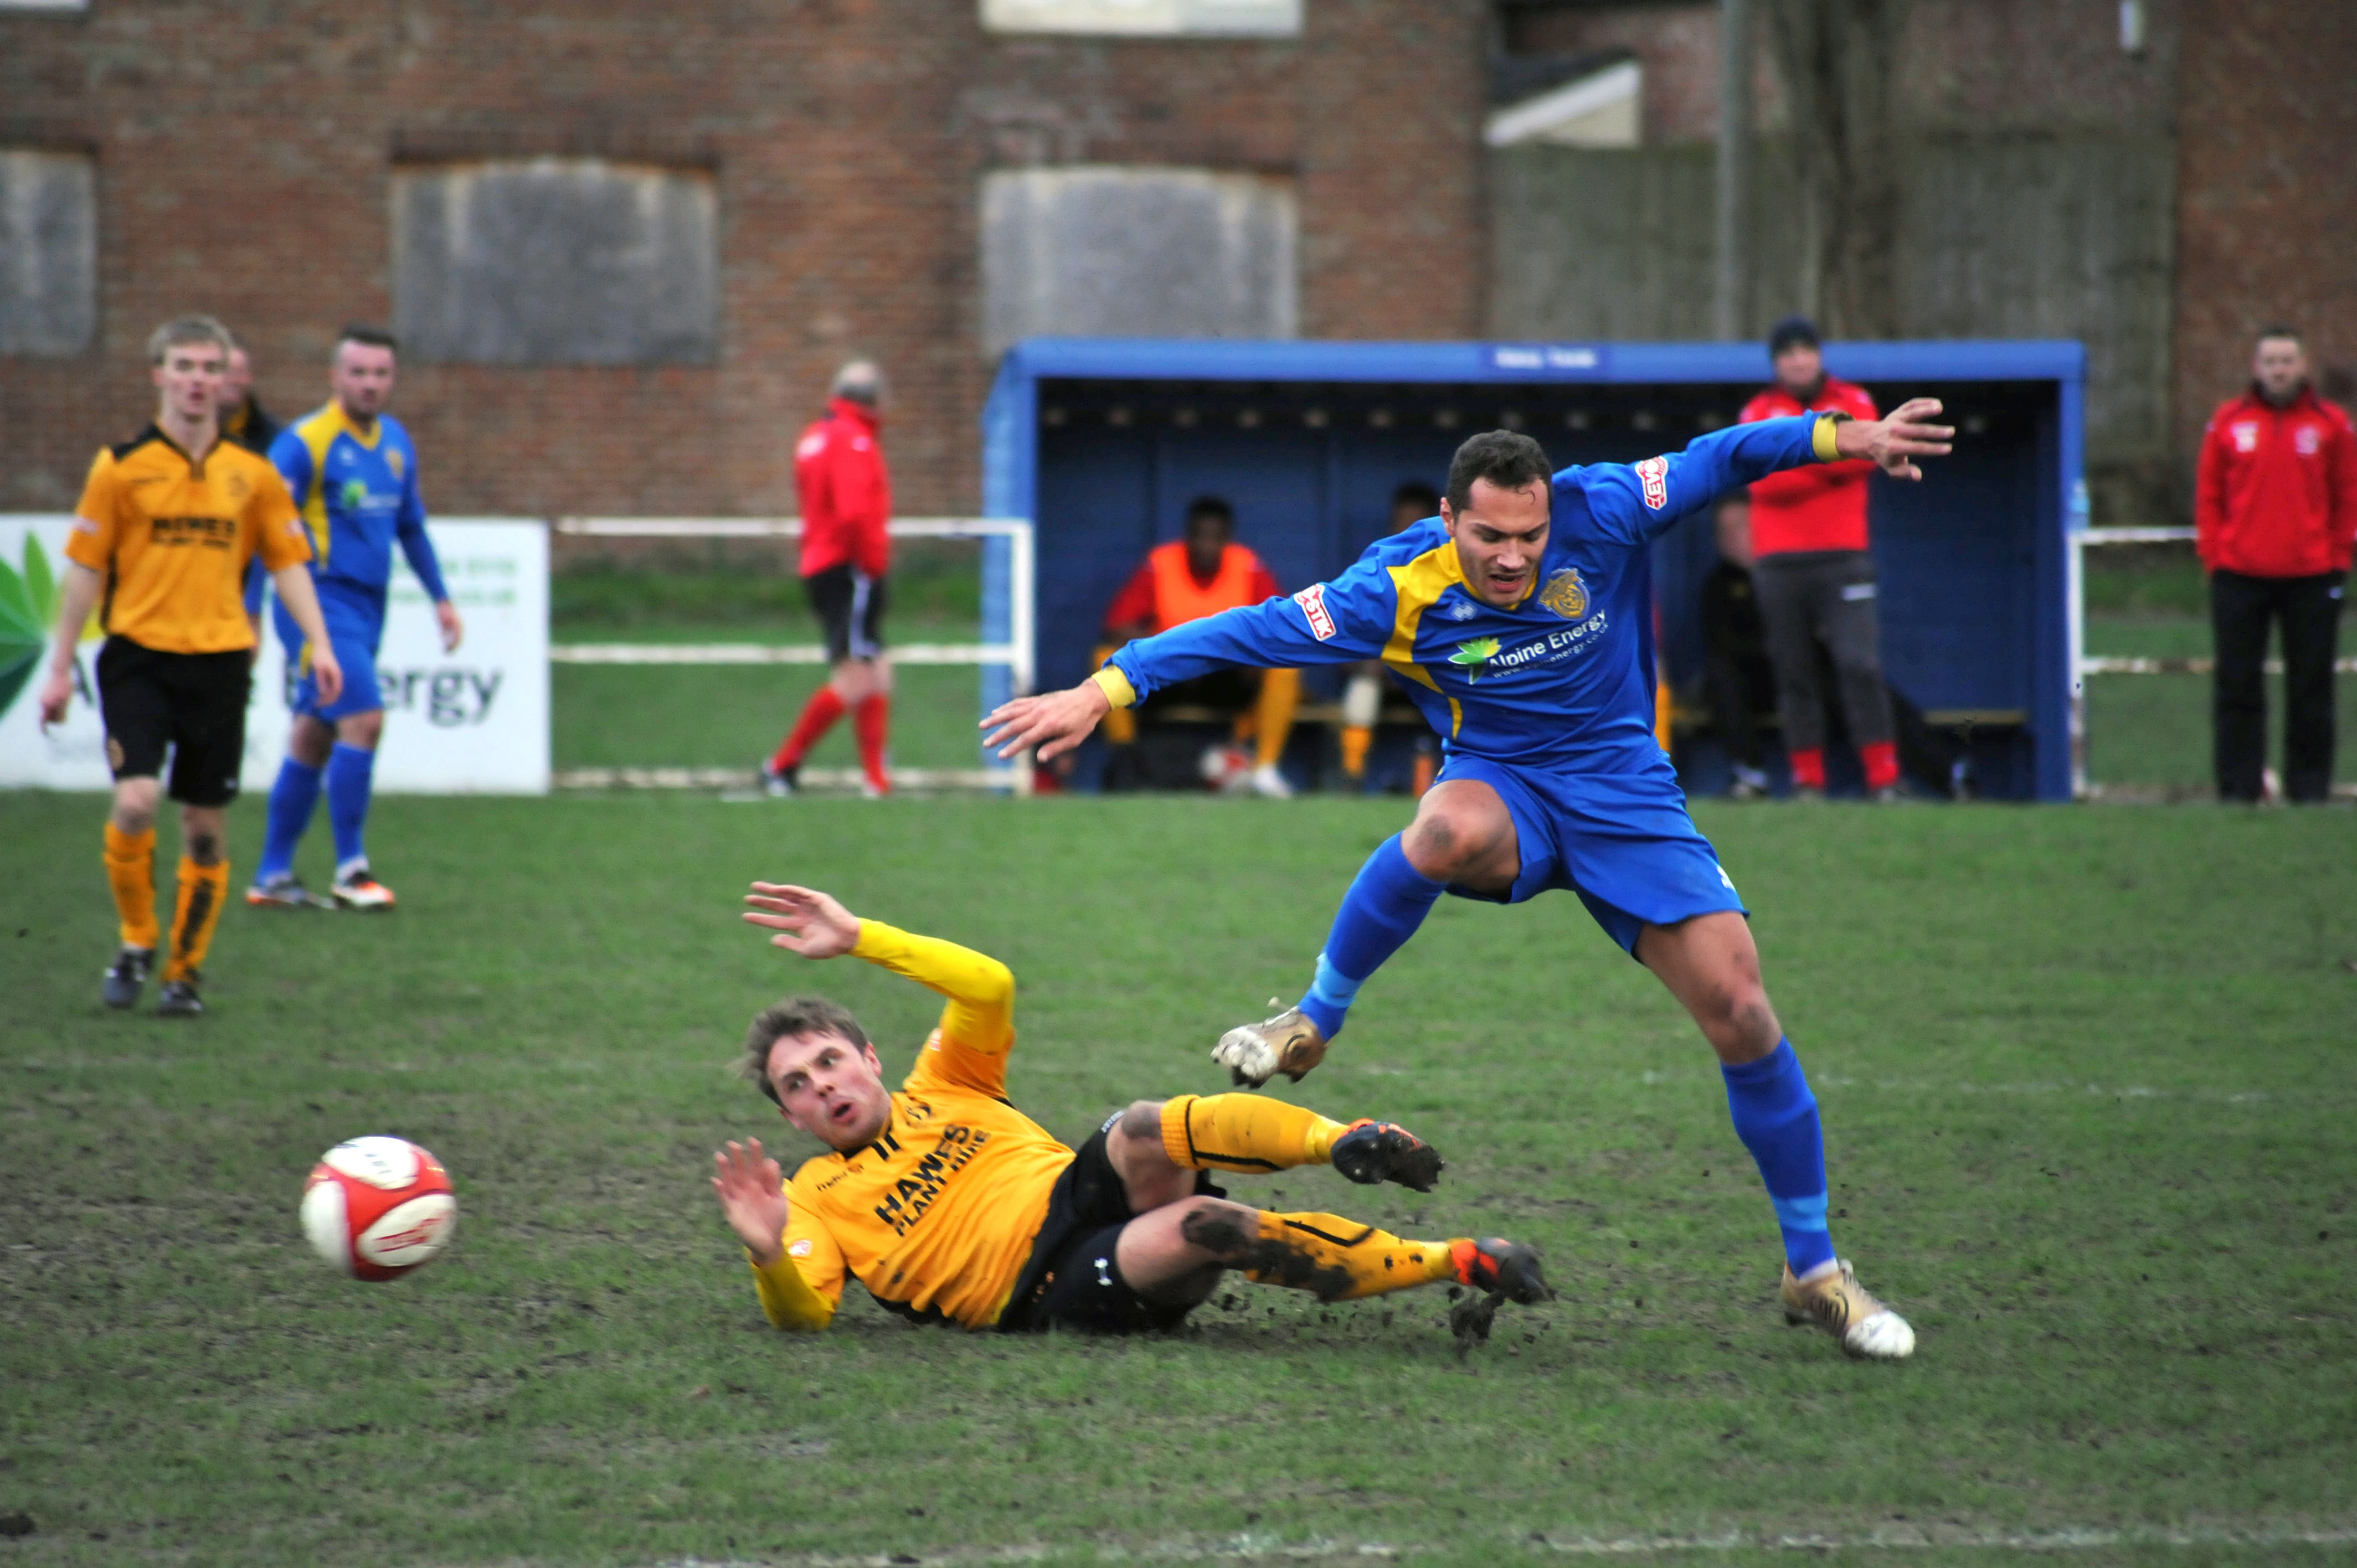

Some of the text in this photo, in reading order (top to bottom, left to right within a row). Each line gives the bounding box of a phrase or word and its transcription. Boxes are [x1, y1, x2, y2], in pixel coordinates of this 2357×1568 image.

[1489, 608, 1605, 666] Alpine Energy
[874, 1123, 970, 1225] HAWES
